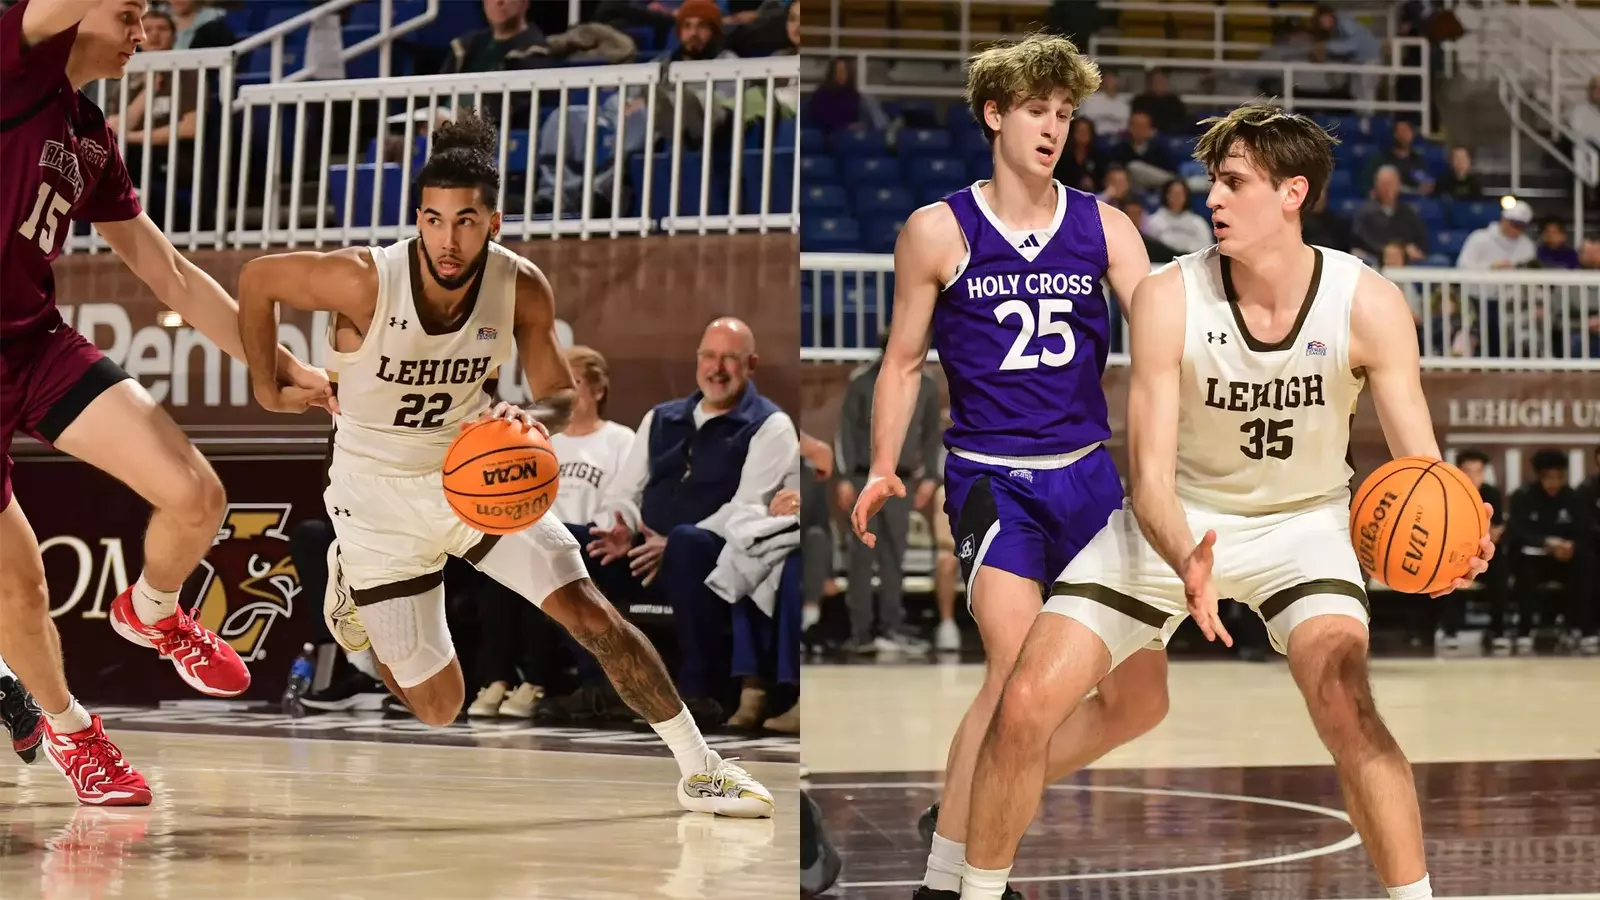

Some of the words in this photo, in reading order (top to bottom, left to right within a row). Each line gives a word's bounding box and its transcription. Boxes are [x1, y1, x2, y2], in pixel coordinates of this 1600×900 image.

[18, 181, 72, 254] 15
[966, 274, 1020, 299] HOLY
[1025, 273, 1093, 295] CROSS
[993, 299, 1076, 370] 25
[376, 355, 491, 386] LEHIGH
[393, 393, 452, 428] 22
[1205, 374, 1325, 412] LEHIGH
[1449, 399, 1564, 427] LEHIGH
[1572, 400, 1600, 427] U
[1240, 417, 1294, 460] 35
[482, 461, 538, 486] NCAA
[475, 491, 549, 530] Wilson
[1359, 491, 1399, 572] Wilson
[1401, 523, 1430, 576] EVO
